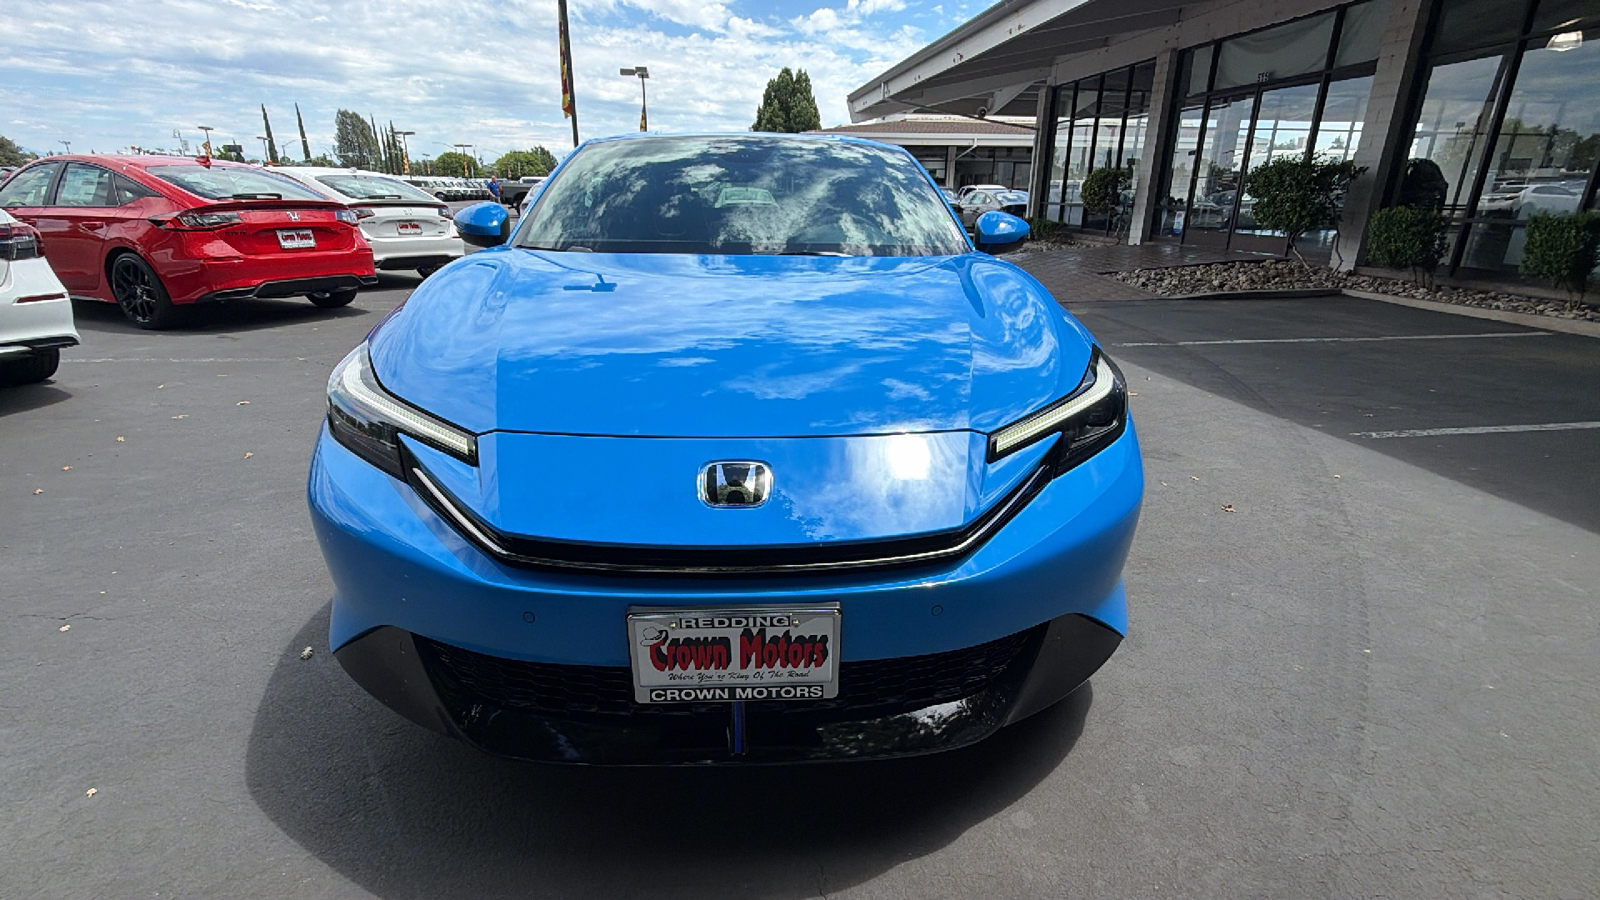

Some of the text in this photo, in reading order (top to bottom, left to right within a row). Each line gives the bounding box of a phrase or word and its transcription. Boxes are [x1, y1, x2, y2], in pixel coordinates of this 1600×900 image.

[681, 616, 789, 629] REDDING
[648, 628, 829, 672] Crown Motors
[667, 670, 811, 683] Where You're King Of The Road
[651, 686, 823, 701] CROWN MOTORS
